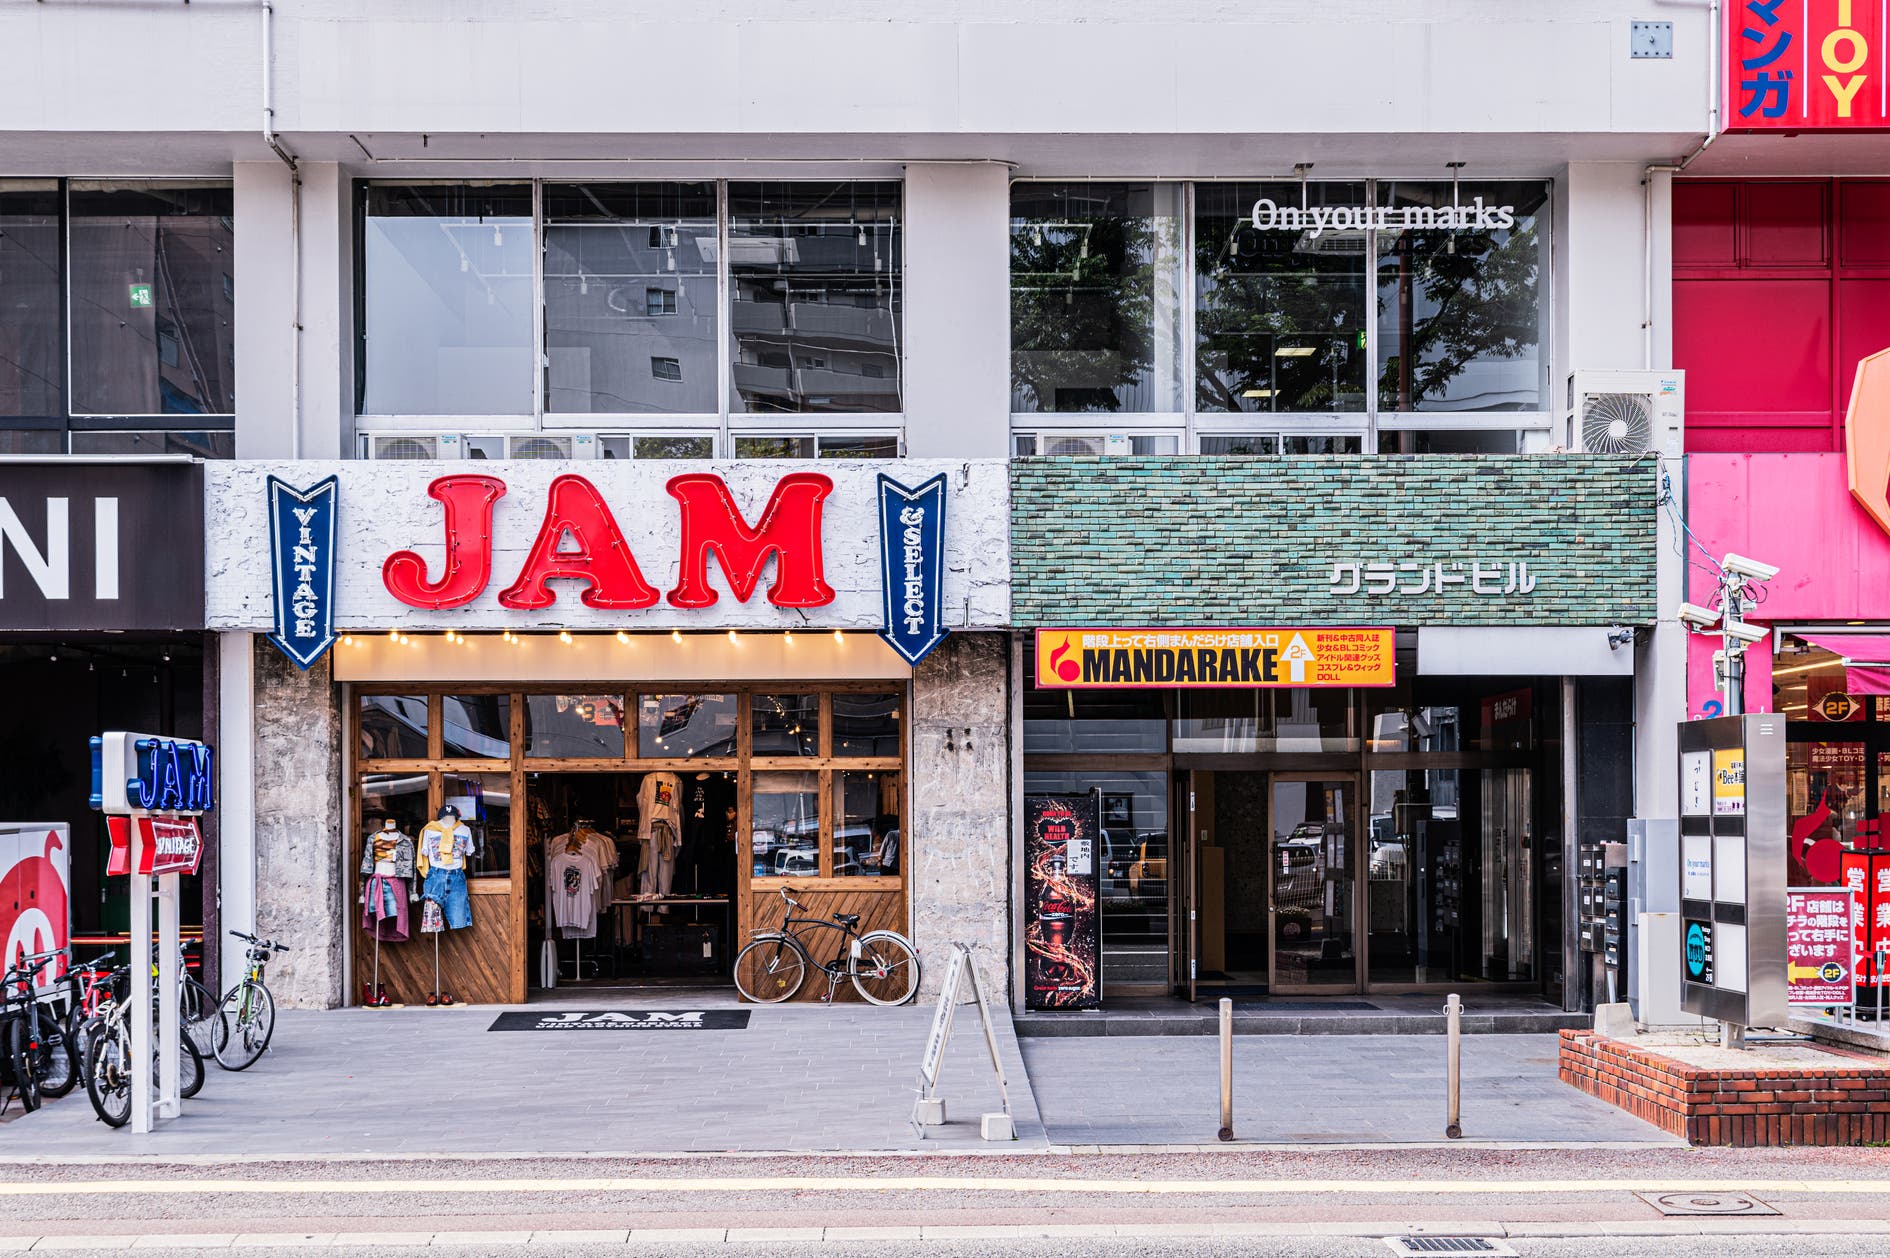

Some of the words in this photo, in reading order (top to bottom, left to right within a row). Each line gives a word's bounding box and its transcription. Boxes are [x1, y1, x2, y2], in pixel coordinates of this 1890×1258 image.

[1738, 0, 1795, 118] マンガ
[1252, 198, 1307, 230] On
[1308, 204, 1394, 239] your
[1402, 196, 1514, 230] marks
[382, 473, 836, 610] JAM
[292, 506, 319, 638] VINTAGE
[1329, 562, 1537, 595] グランドビル
[1081, 633, 1279, 648] 階段上って右側まんだらけ店舗入口
[1290, 645, 1307, 659] 2F
[1082, 648, 1279, 683] MANDARAKE
[1316, 673, 1341, 681] DOLL
[1826, 701, 1849, 715] 2F
[126, 738, 214, 811] JAM
[1824, 968, 1840, 979] 2F
[541, 1012, 706, 1022] JAM
